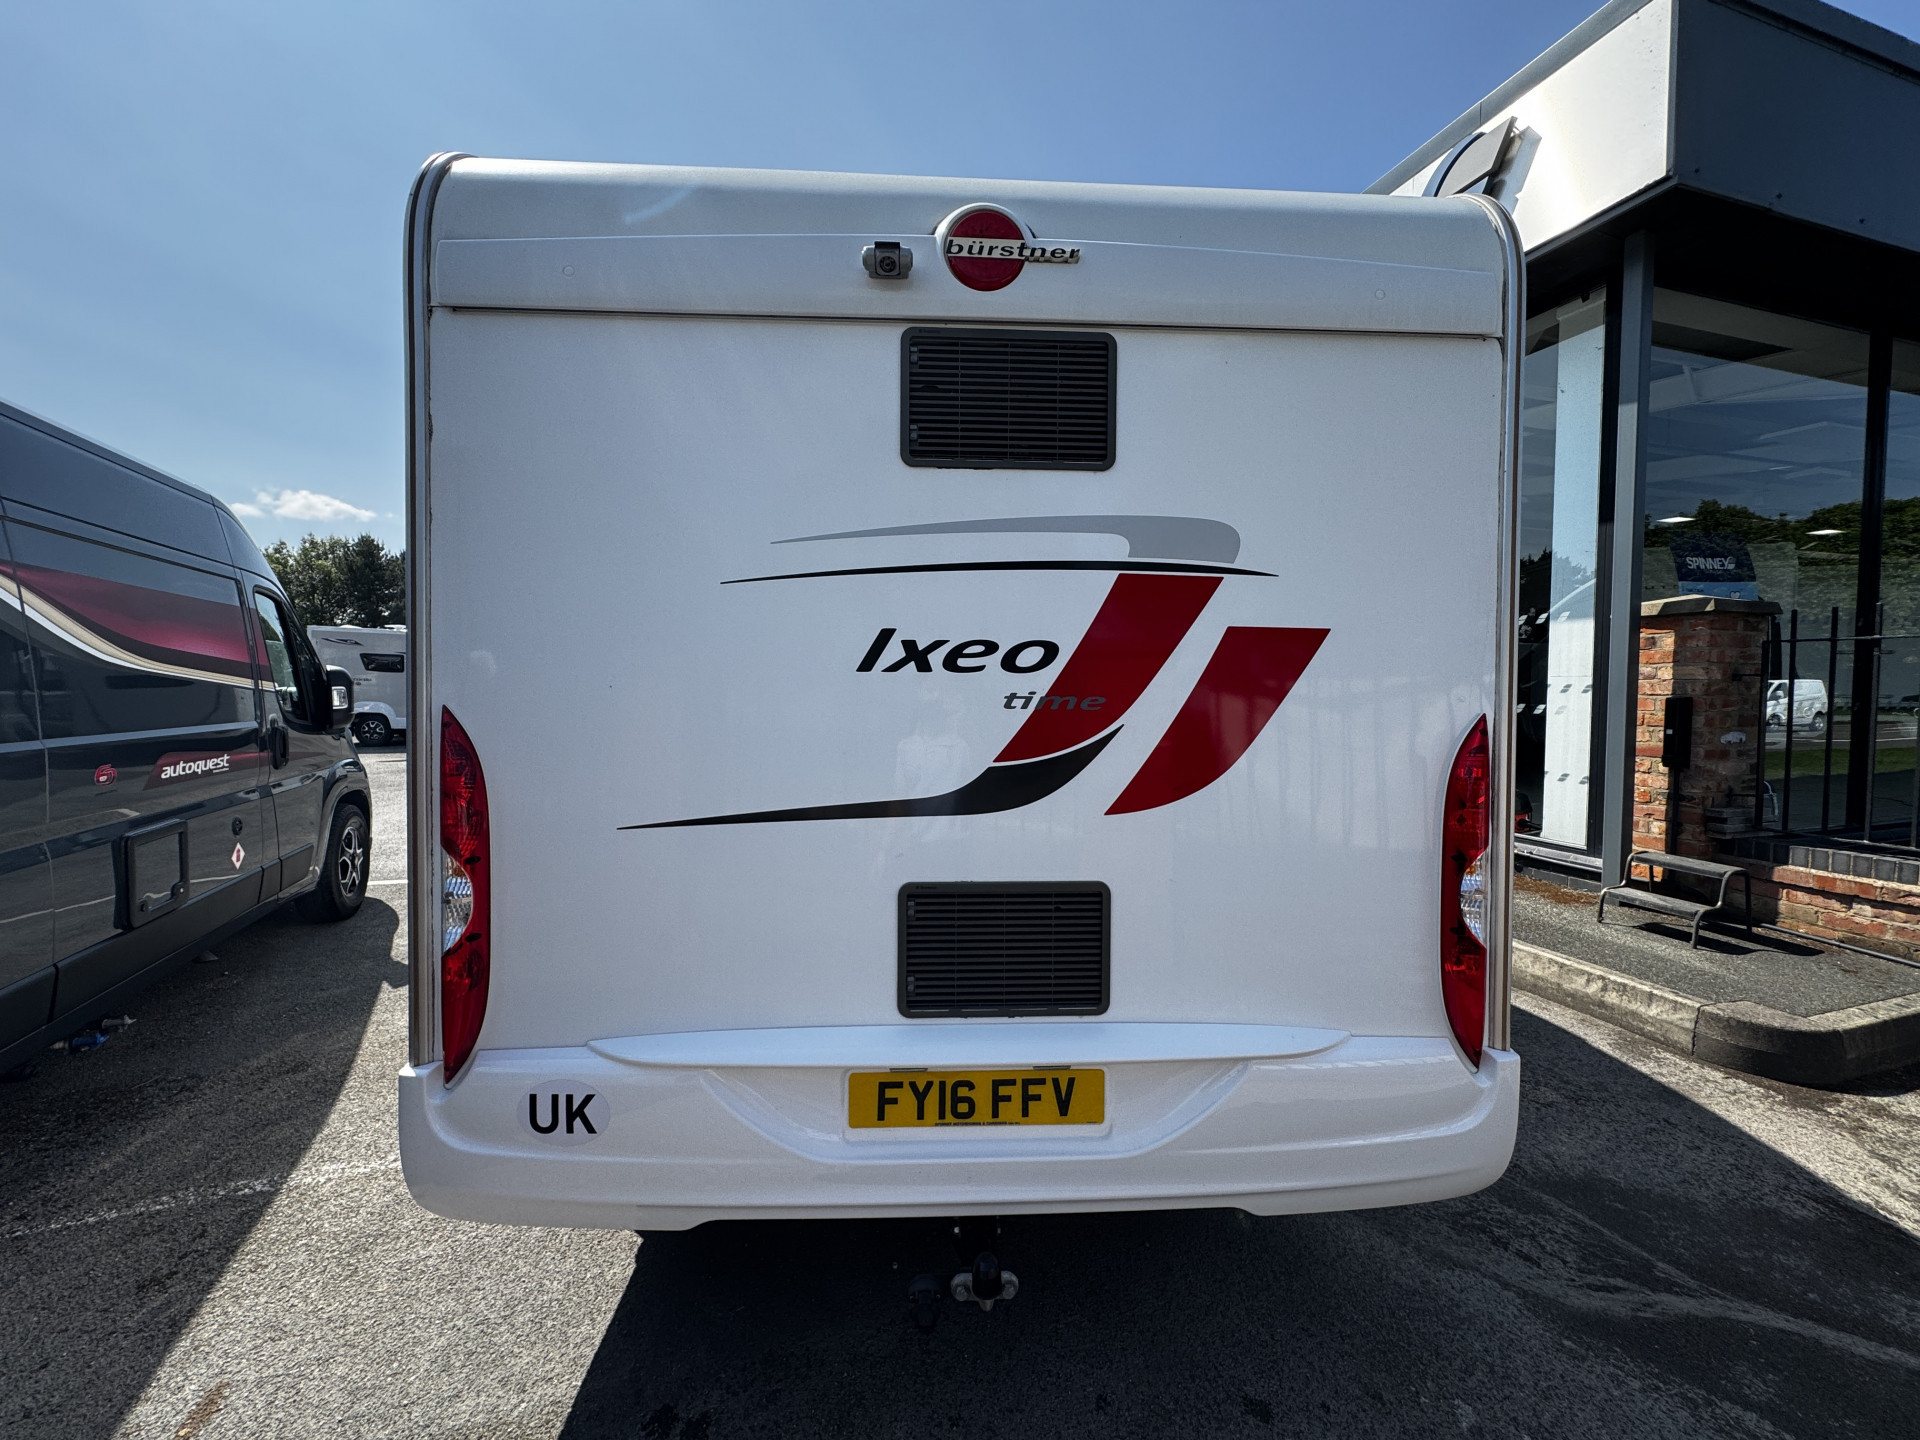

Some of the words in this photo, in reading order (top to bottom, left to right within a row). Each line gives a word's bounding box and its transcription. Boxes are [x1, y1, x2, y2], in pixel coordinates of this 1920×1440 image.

[945, 238, 1081, 262] bürstner
[1685, 556, 1729, 570] SPINNEY
[855, 627, 1060, 674] Ixeo
[1003, 691, 1106, 711] time
[160, 753, 231, 779] autoquest
[876, 1079, 976, 1121] FY16
[991, 1076, 1076, 1119] FFV
[529, 1093, 597, 1134] UK
